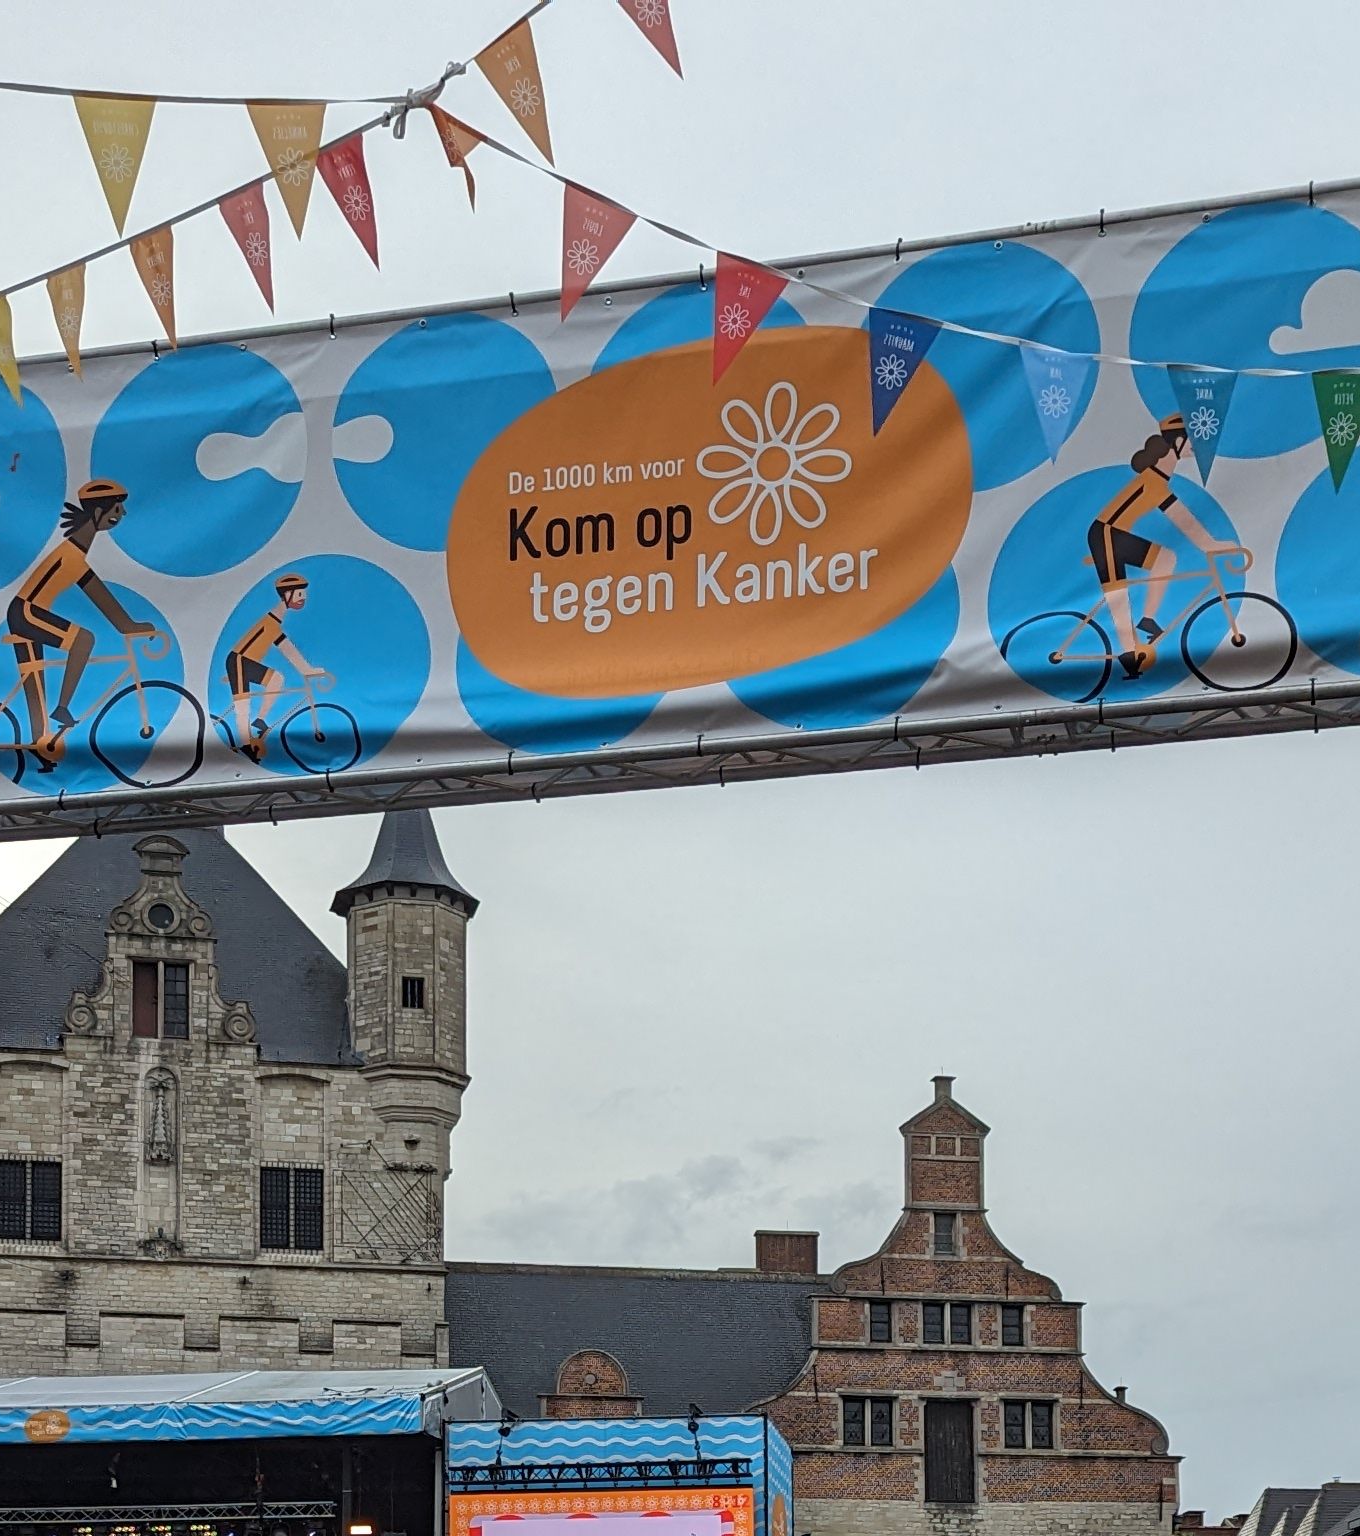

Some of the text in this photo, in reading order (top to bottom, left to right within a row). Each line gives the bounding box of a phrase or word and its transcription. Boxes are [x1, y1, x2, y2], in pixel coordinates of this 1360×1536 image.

[508, 457, 686, 496] De 1000 km voor
[508, 502, 692, 562] Kom op
[529, 542, 879, 634] tegen Kanker
